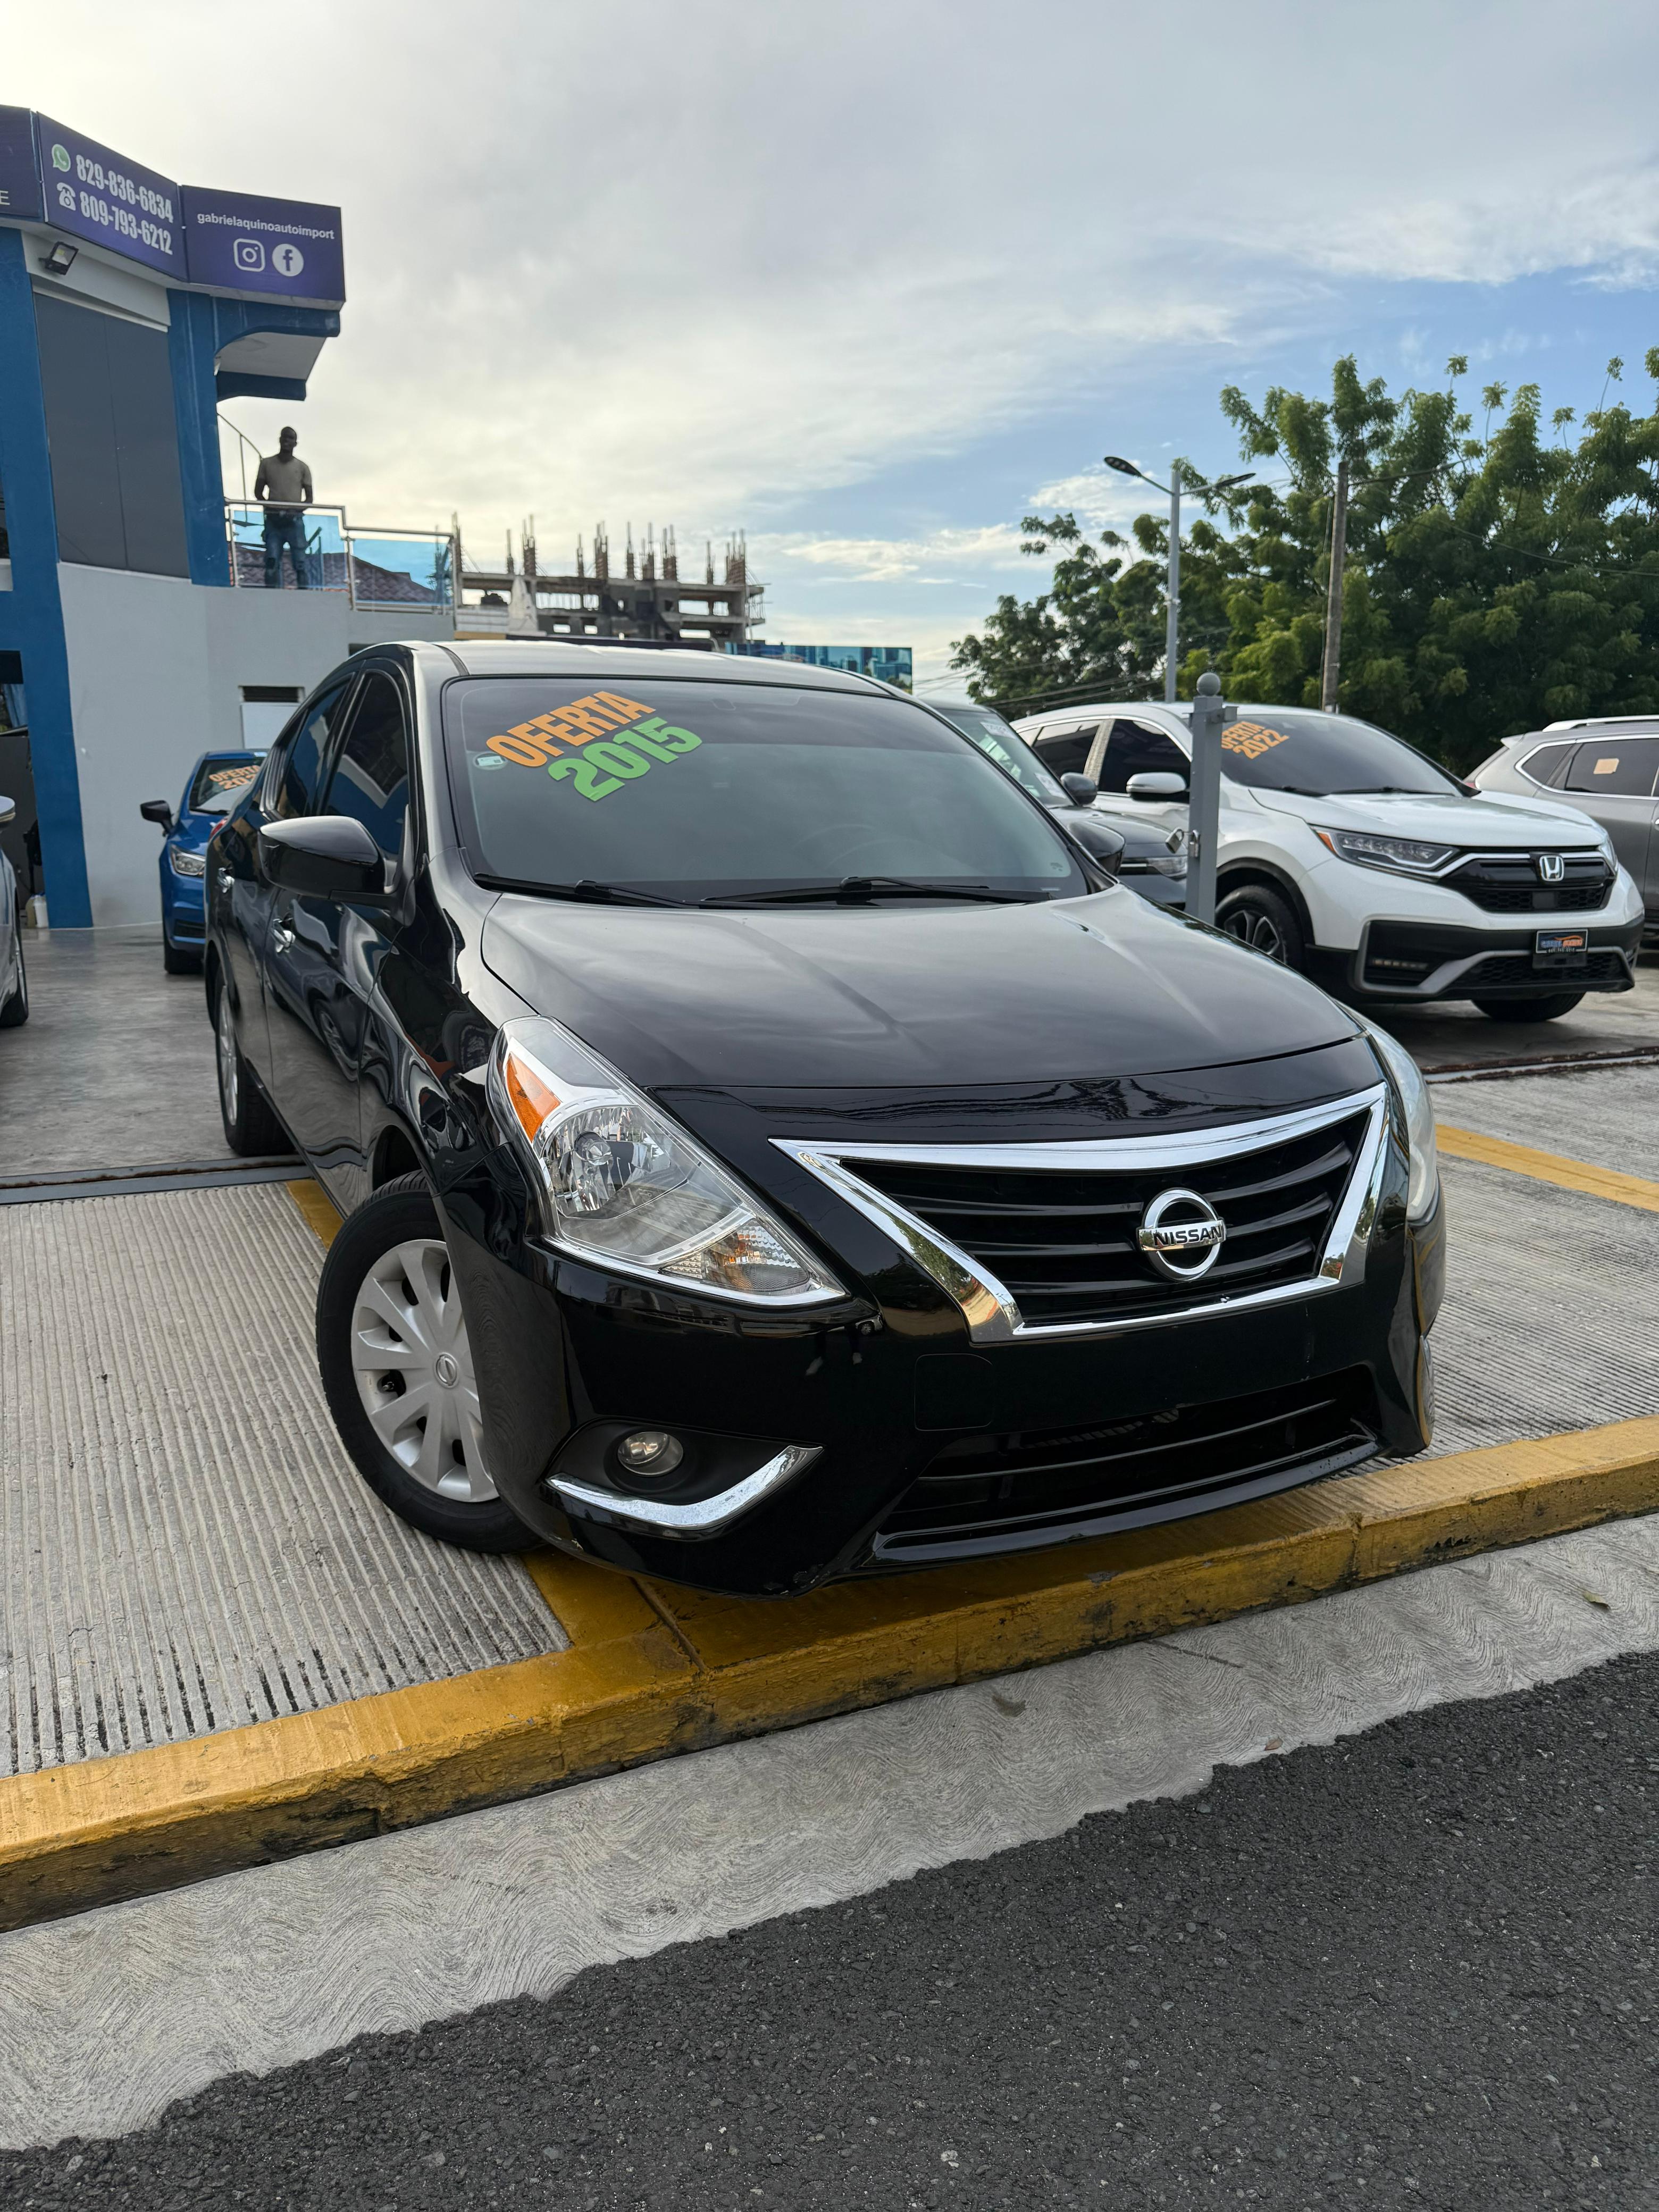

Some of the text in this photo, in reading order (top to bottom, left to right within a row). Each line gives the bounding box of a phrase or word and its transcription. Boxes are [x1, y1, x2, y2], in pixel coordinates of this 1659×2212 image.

[76, 155, 173, 223] 829-836-6834
[80, 191, 173, 255] 809-793-6212
[197, 213, 334, 239] gabrielaquinoautoimport
[486, 691, 656, 768] OFERTA
[548, 717, 702, 802] 2015
[1233, 729, 1289, 759] 2022
[1153, 1225, 1222, 1246] NISSAN
